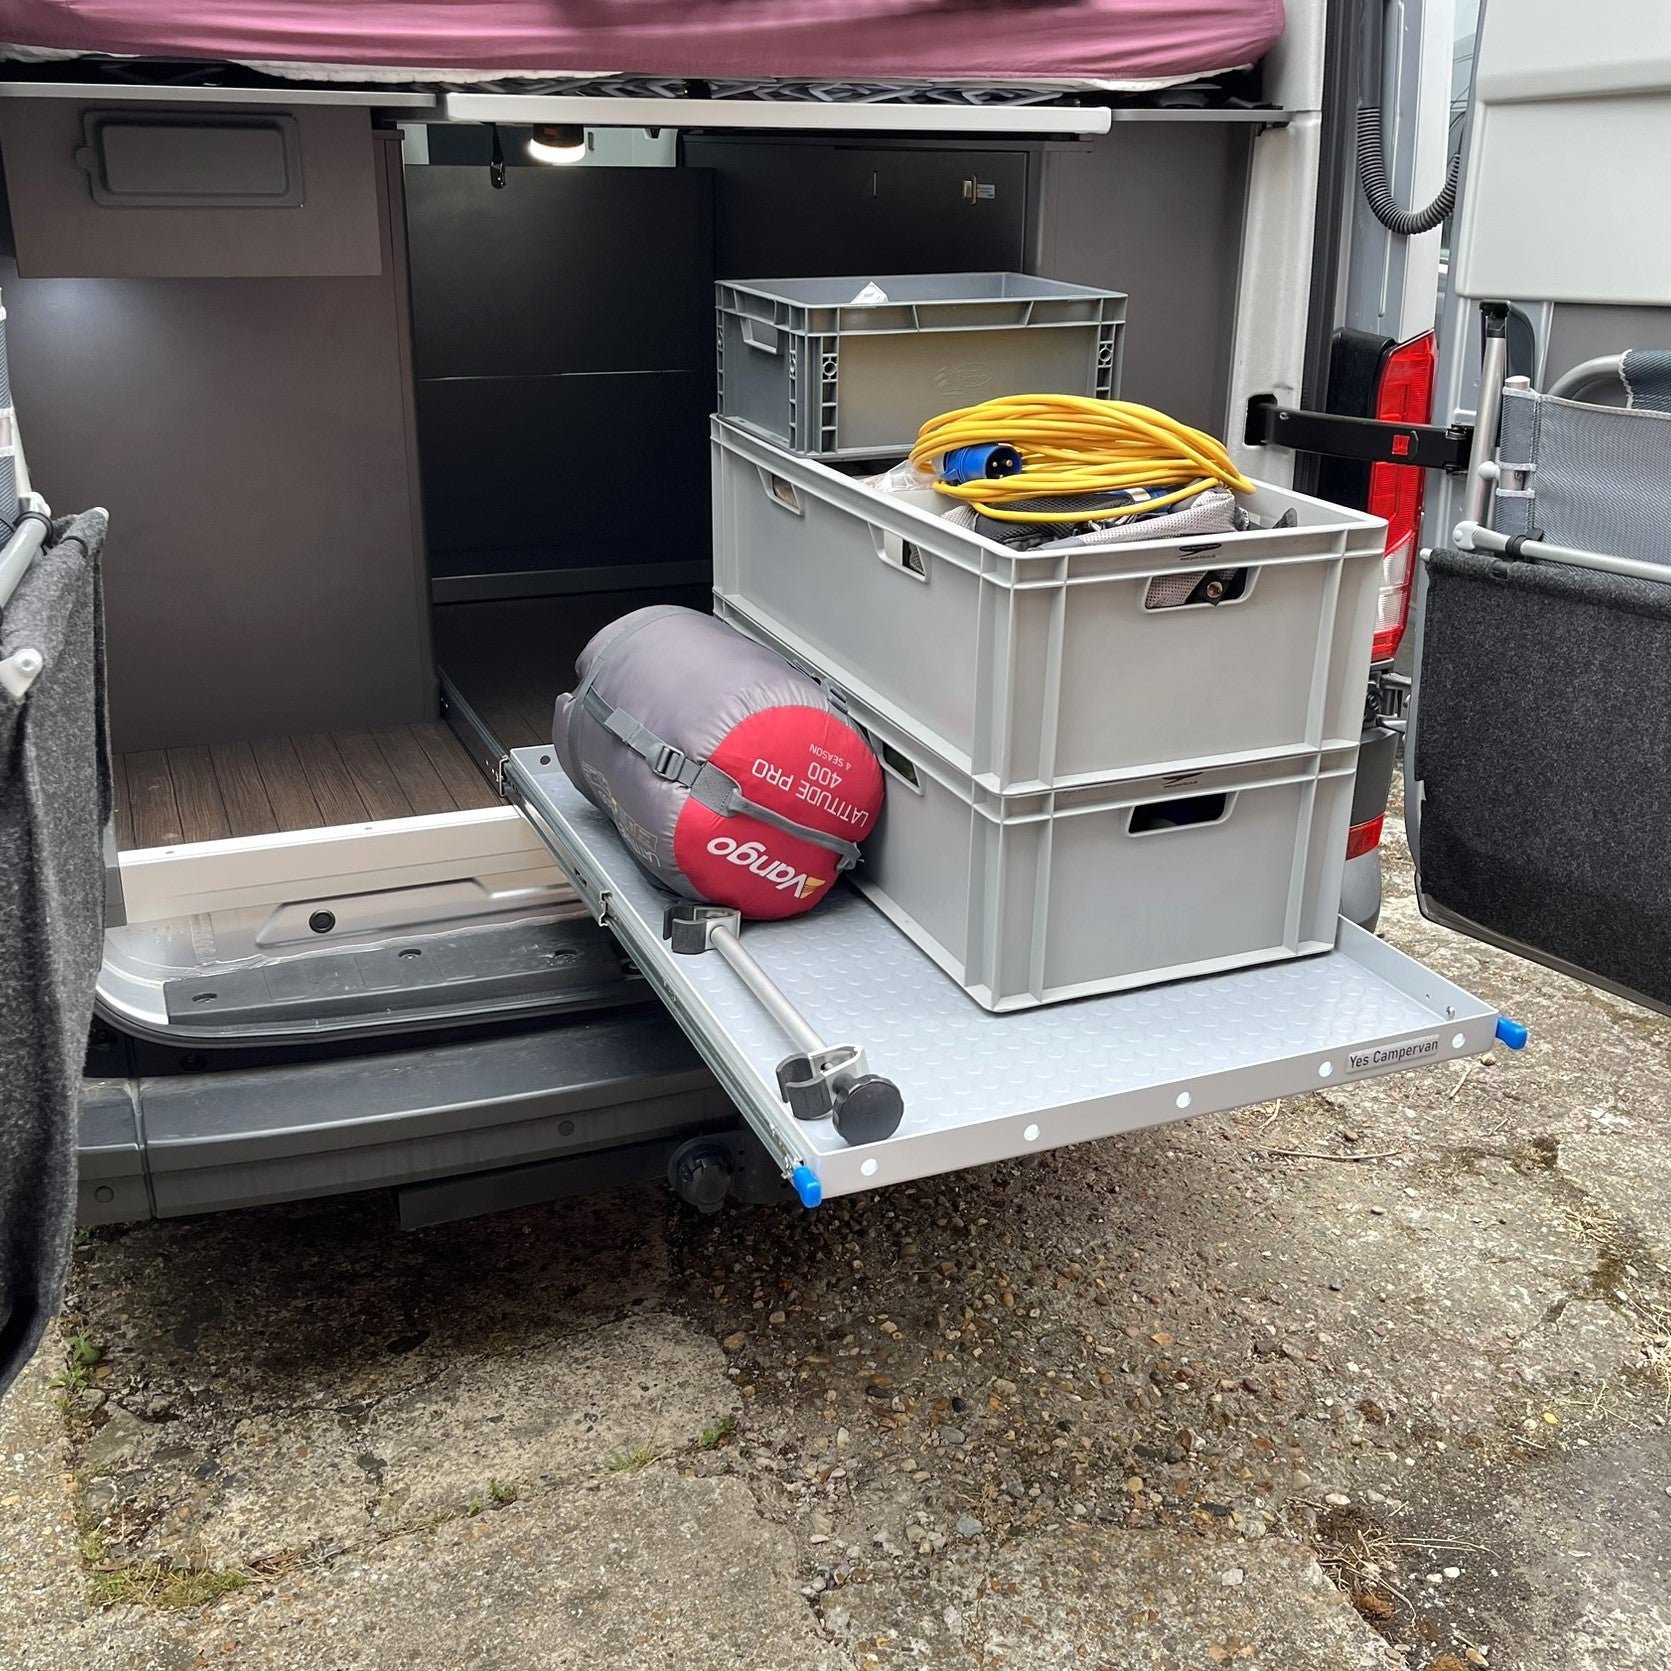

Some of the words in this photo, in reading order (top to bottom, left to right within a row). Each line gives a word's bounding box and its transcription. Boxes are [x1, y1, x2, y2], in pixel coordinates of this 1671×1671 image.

[809, 743, 844, 767] SEASON
[845, 761, 852, 771] 4
[752, 758, 794, 792] PRO
[808, 762, 843, 789] 400
[795, 780, 869, 828] LATITUDE
[707, 837, 807, 898] Vango
[1350, 1056, 1369, 1068] Yes
[1373, 1040, 1439, 1064] Campervan
